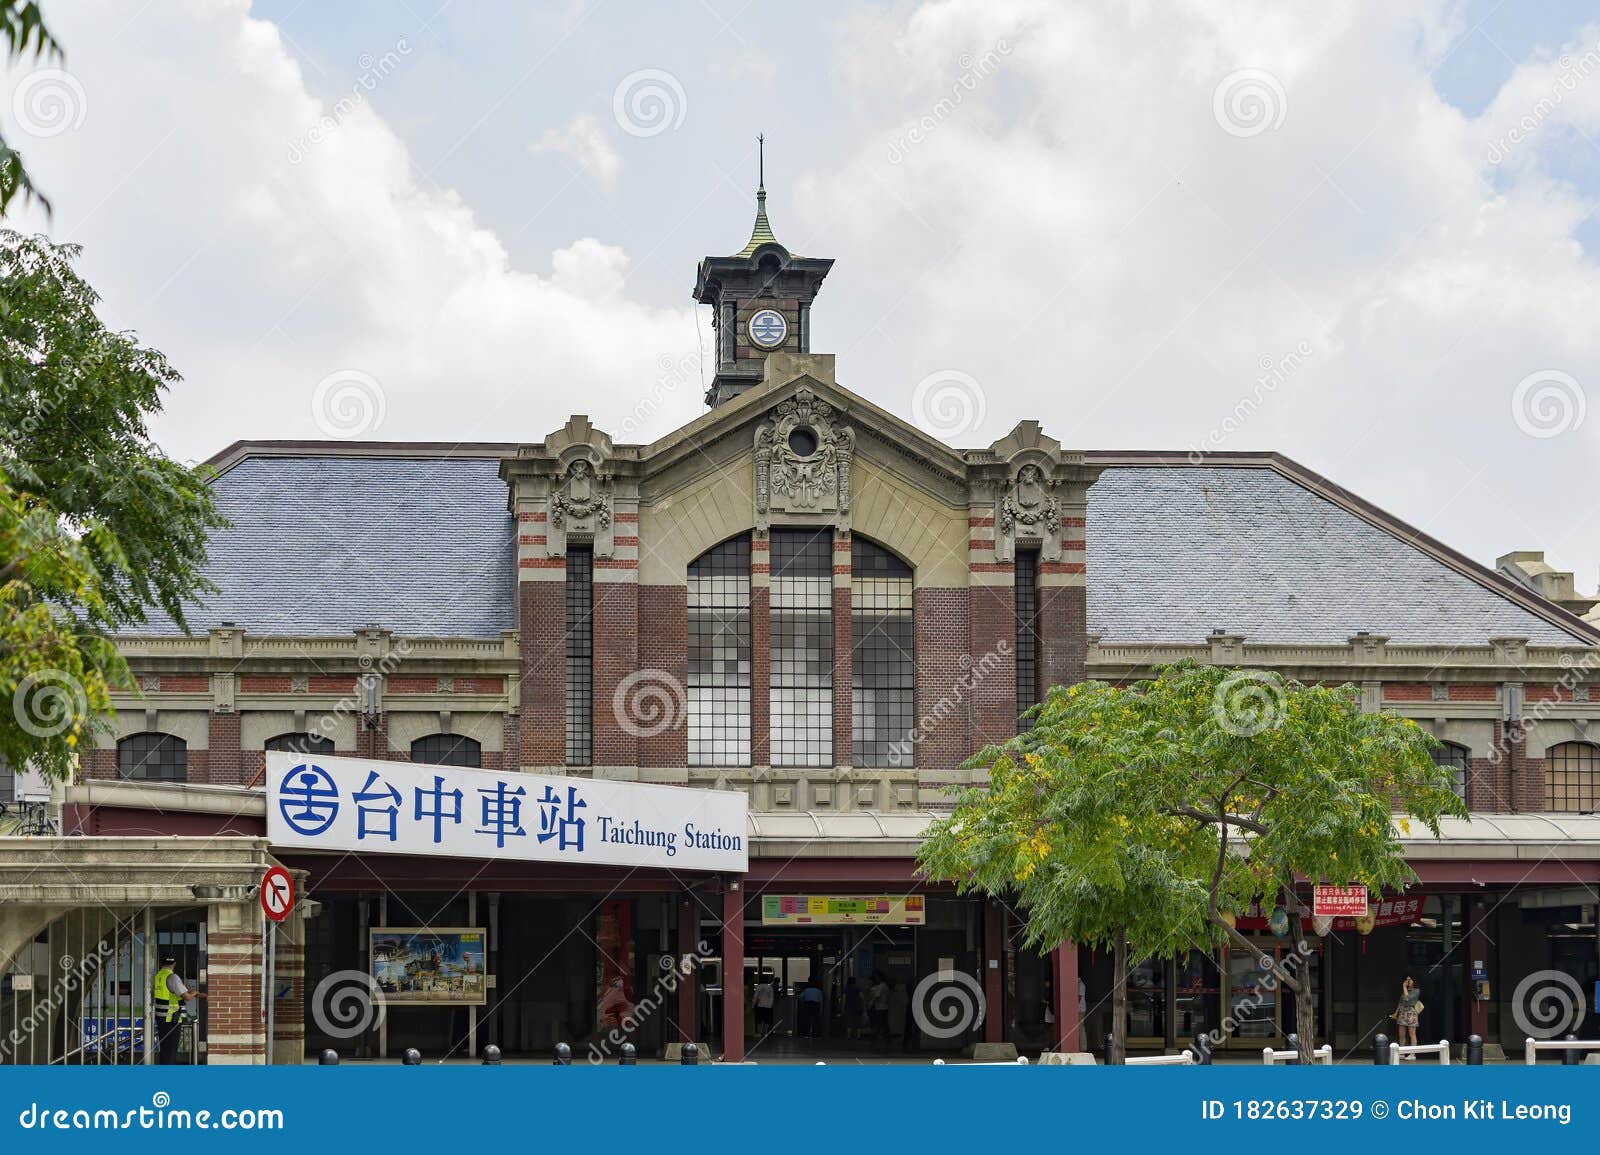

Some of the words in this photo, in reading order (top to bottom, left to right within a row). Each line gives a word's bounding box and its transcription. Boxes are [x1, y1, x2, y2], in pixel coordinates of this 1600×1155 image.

[351, 770, 587, 853] 台中車站
[597, 815, 677, 857] Taichung
[684, 822, 742, 851] Station
